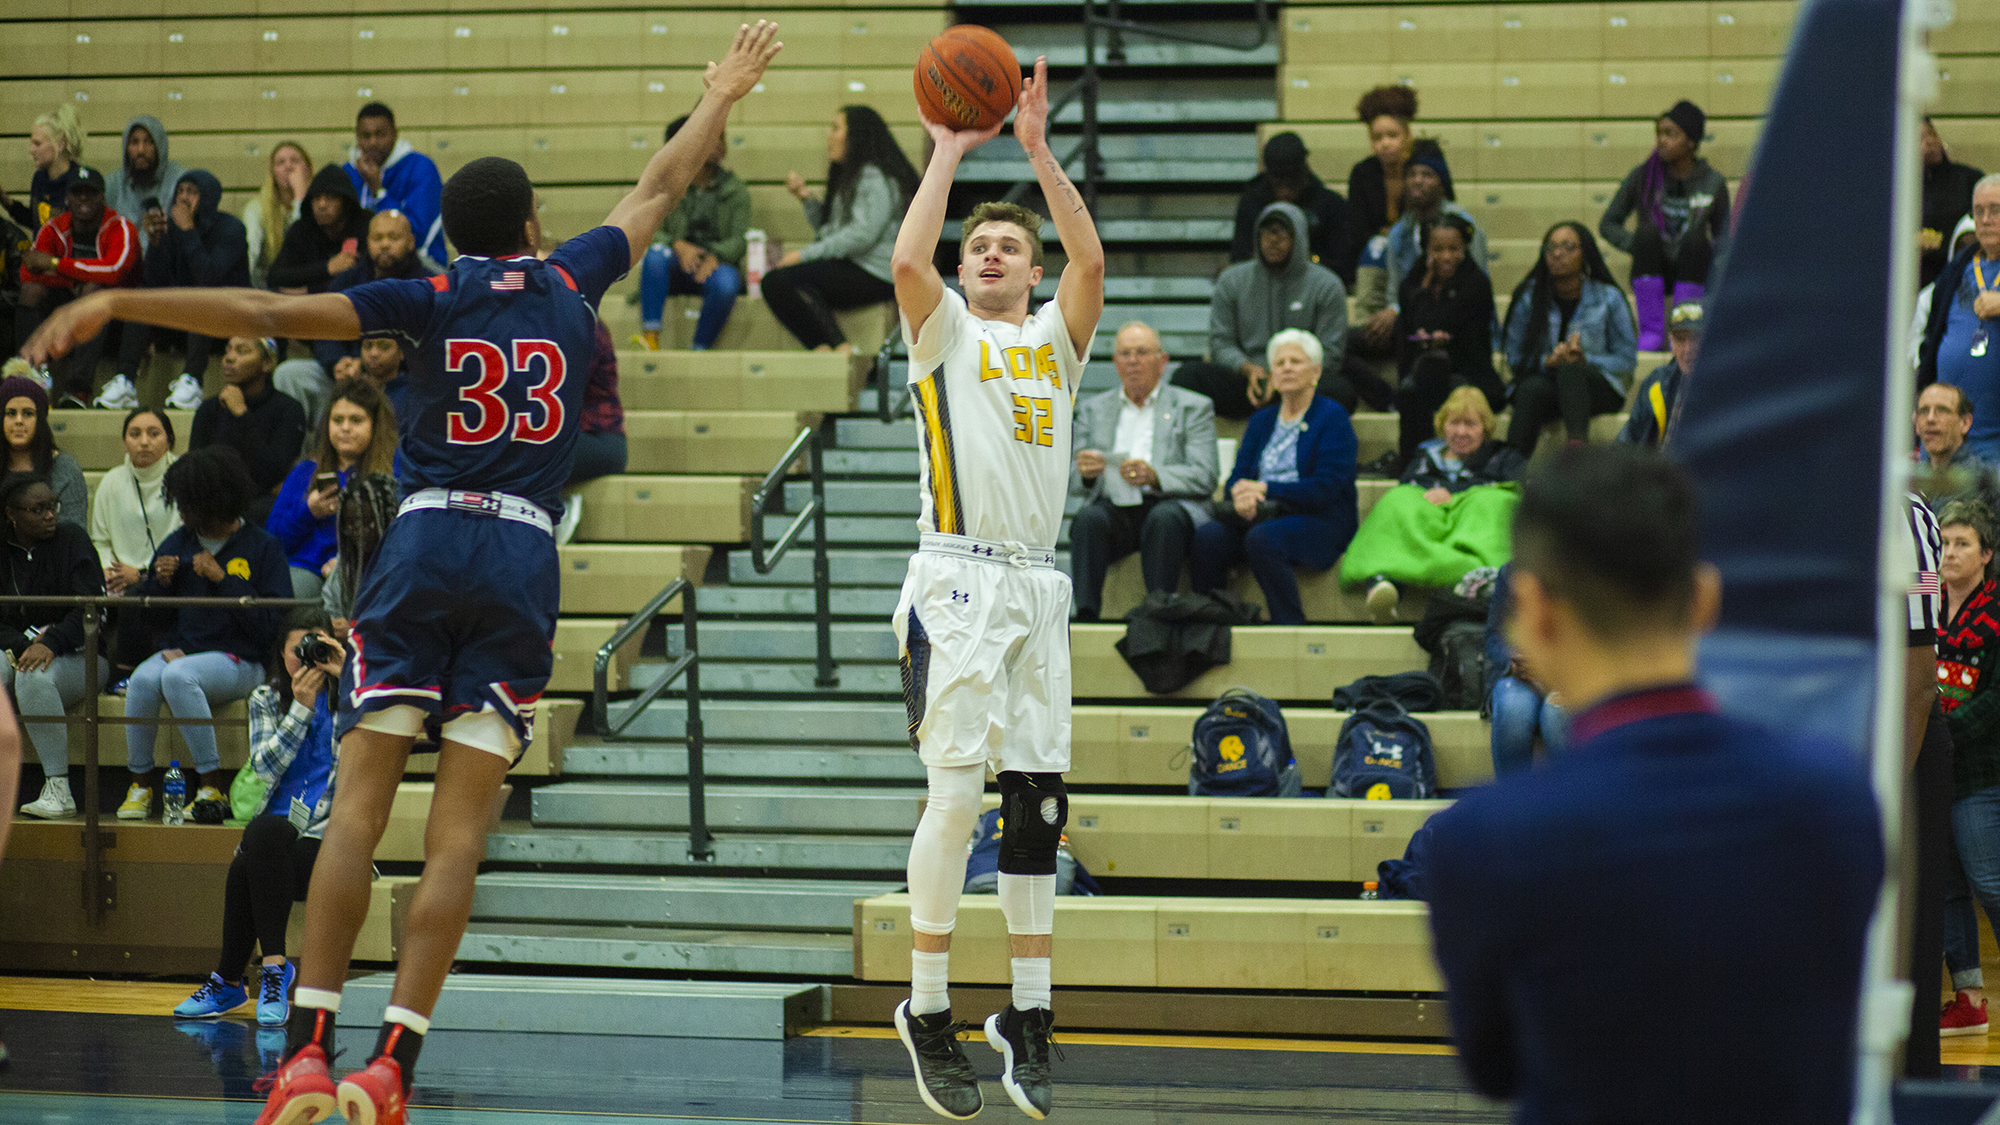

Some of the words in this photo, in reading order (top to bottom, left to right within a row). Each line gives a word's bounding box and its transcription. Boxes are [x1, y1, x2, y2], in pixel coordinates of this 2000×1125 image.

[445, 338, 568, 445] 33
[978, 339, 1062, 390] LONS
[1010, 392, 1053, 448] 32
